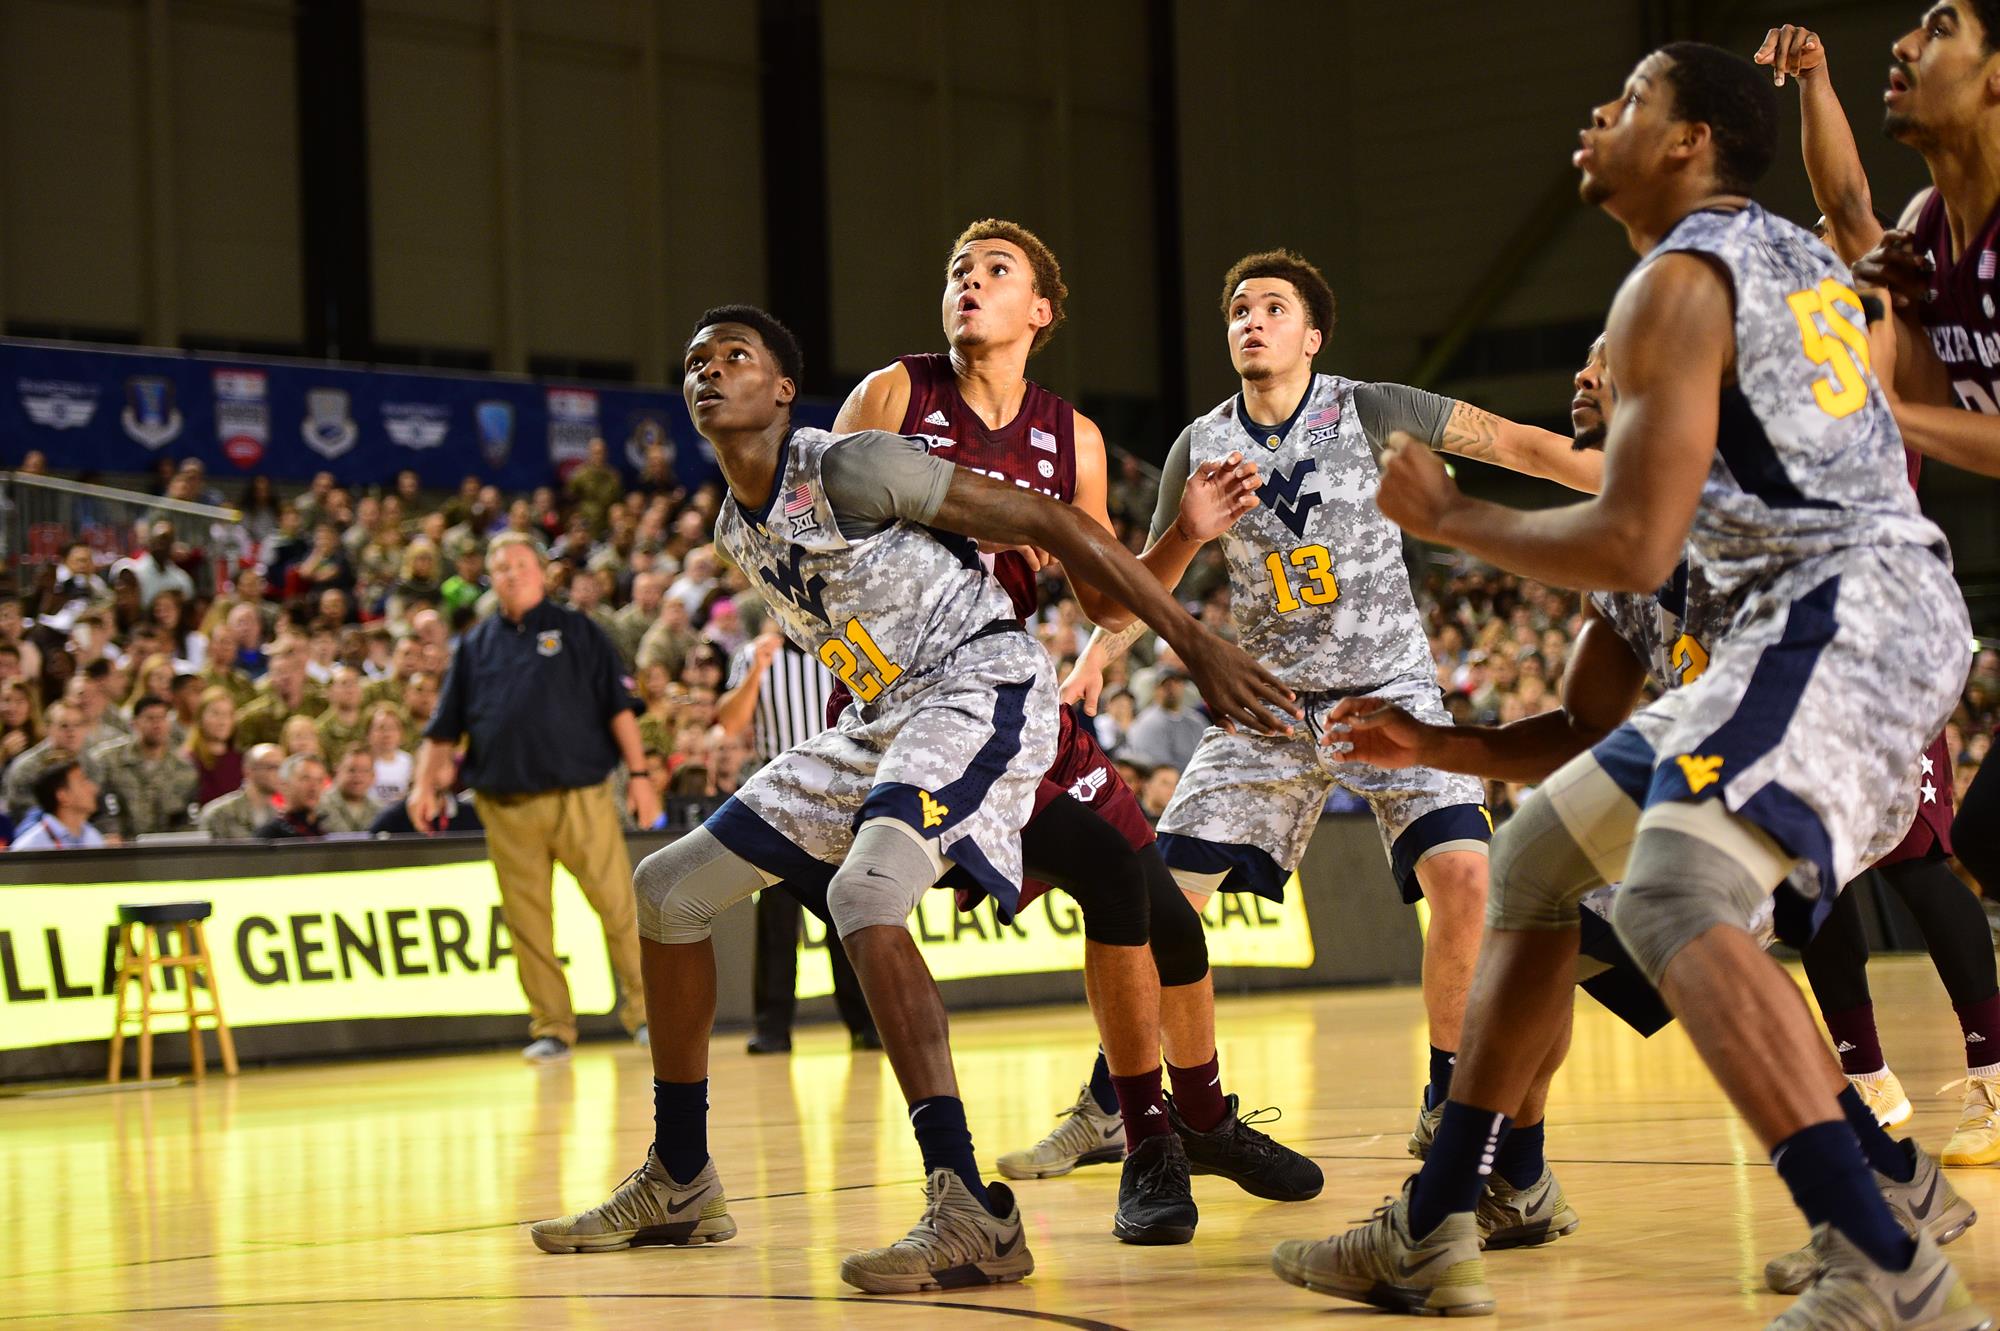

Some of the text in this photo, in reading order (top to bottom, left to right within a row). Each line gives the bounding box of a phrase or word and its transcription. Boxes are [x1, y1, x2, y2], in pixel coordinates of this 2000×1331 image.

[1265, 543, 1340, 614] 13
[818, 616, 905, 703] 21
[236, 905, 570, 984] GENERA
